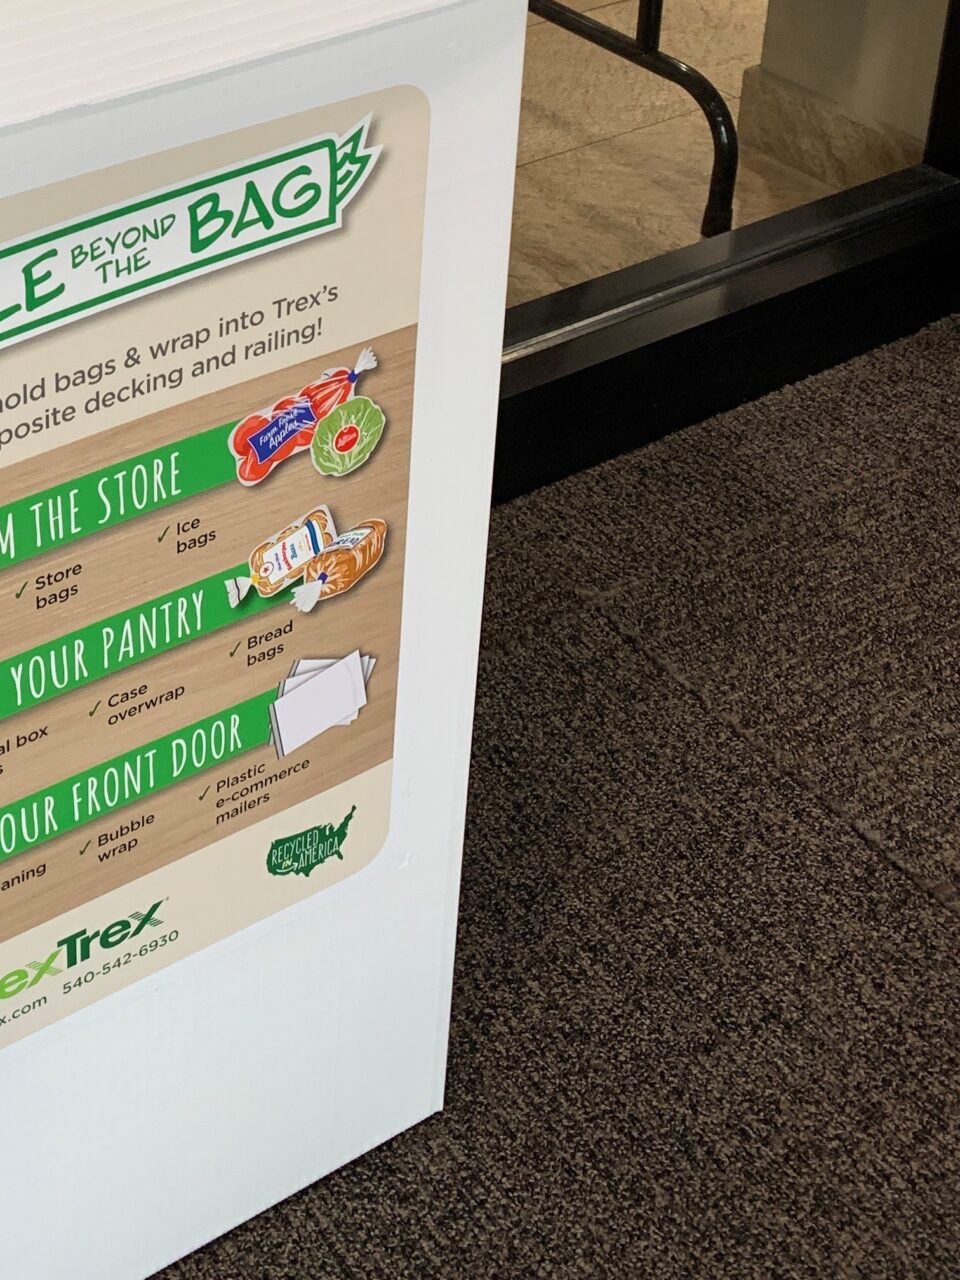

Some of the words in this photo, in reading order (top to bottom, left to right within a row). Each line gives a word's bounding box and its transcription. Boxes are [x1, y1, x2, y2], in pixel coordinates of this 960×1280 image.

[187, 165, 322, 254] BAG
[71, 213, 176, 270] BEYOND
[95, 247, 151, 285] THE
[54, 354, 117, 394] bags
[123, 347, 142, 368] &
[149, 327, 211, 360] wrap
[218, 308, 265, 338] into
[272, 285, 339, 320] Trex's
[84, 368, 184, 415] decking
[191, 345, 237, 377] and
[244, 317, 324, 361] railing!
[259, 426, 280, 447] Farm
[268, 420, 299, 450] Apples
[29, 488, 83, 548] THE
[97, 450, 183, 525] STORE
[176, 518, 201, 537] Ice
[176, 531, 217, 554] bags
[35, 563, 83, 591] Store
[36, 583, 79, 610] bags
[10, 639, 89, 706] YOUR
[102, 589, 204, 669] PANTRY
[247, 620, 294, 651] Bread
[247, 642, 285, 667] bags
[107, 683, 148, 708] Case
[107, 685, 186, 726] overwrap
[15, 726, 49, 748] box
[71, 749, 157, 821] FRONT
[172, 714, 242, 778] DOOR
[216, 761, 267, 794] Plastic
[216, 758, 310, 809] e-commerce
[215, 793, 271, 826] mailers
[97, 812, 156, 848] Bubble
[97, 837, 139, 863] wrap
[271, 829, 319, 866] RECYCLED
[282, 858, 293, 869] IN
[297, 836, 339, 870] AMERICA
[62, 929, 180, 995] 540-542-6930
